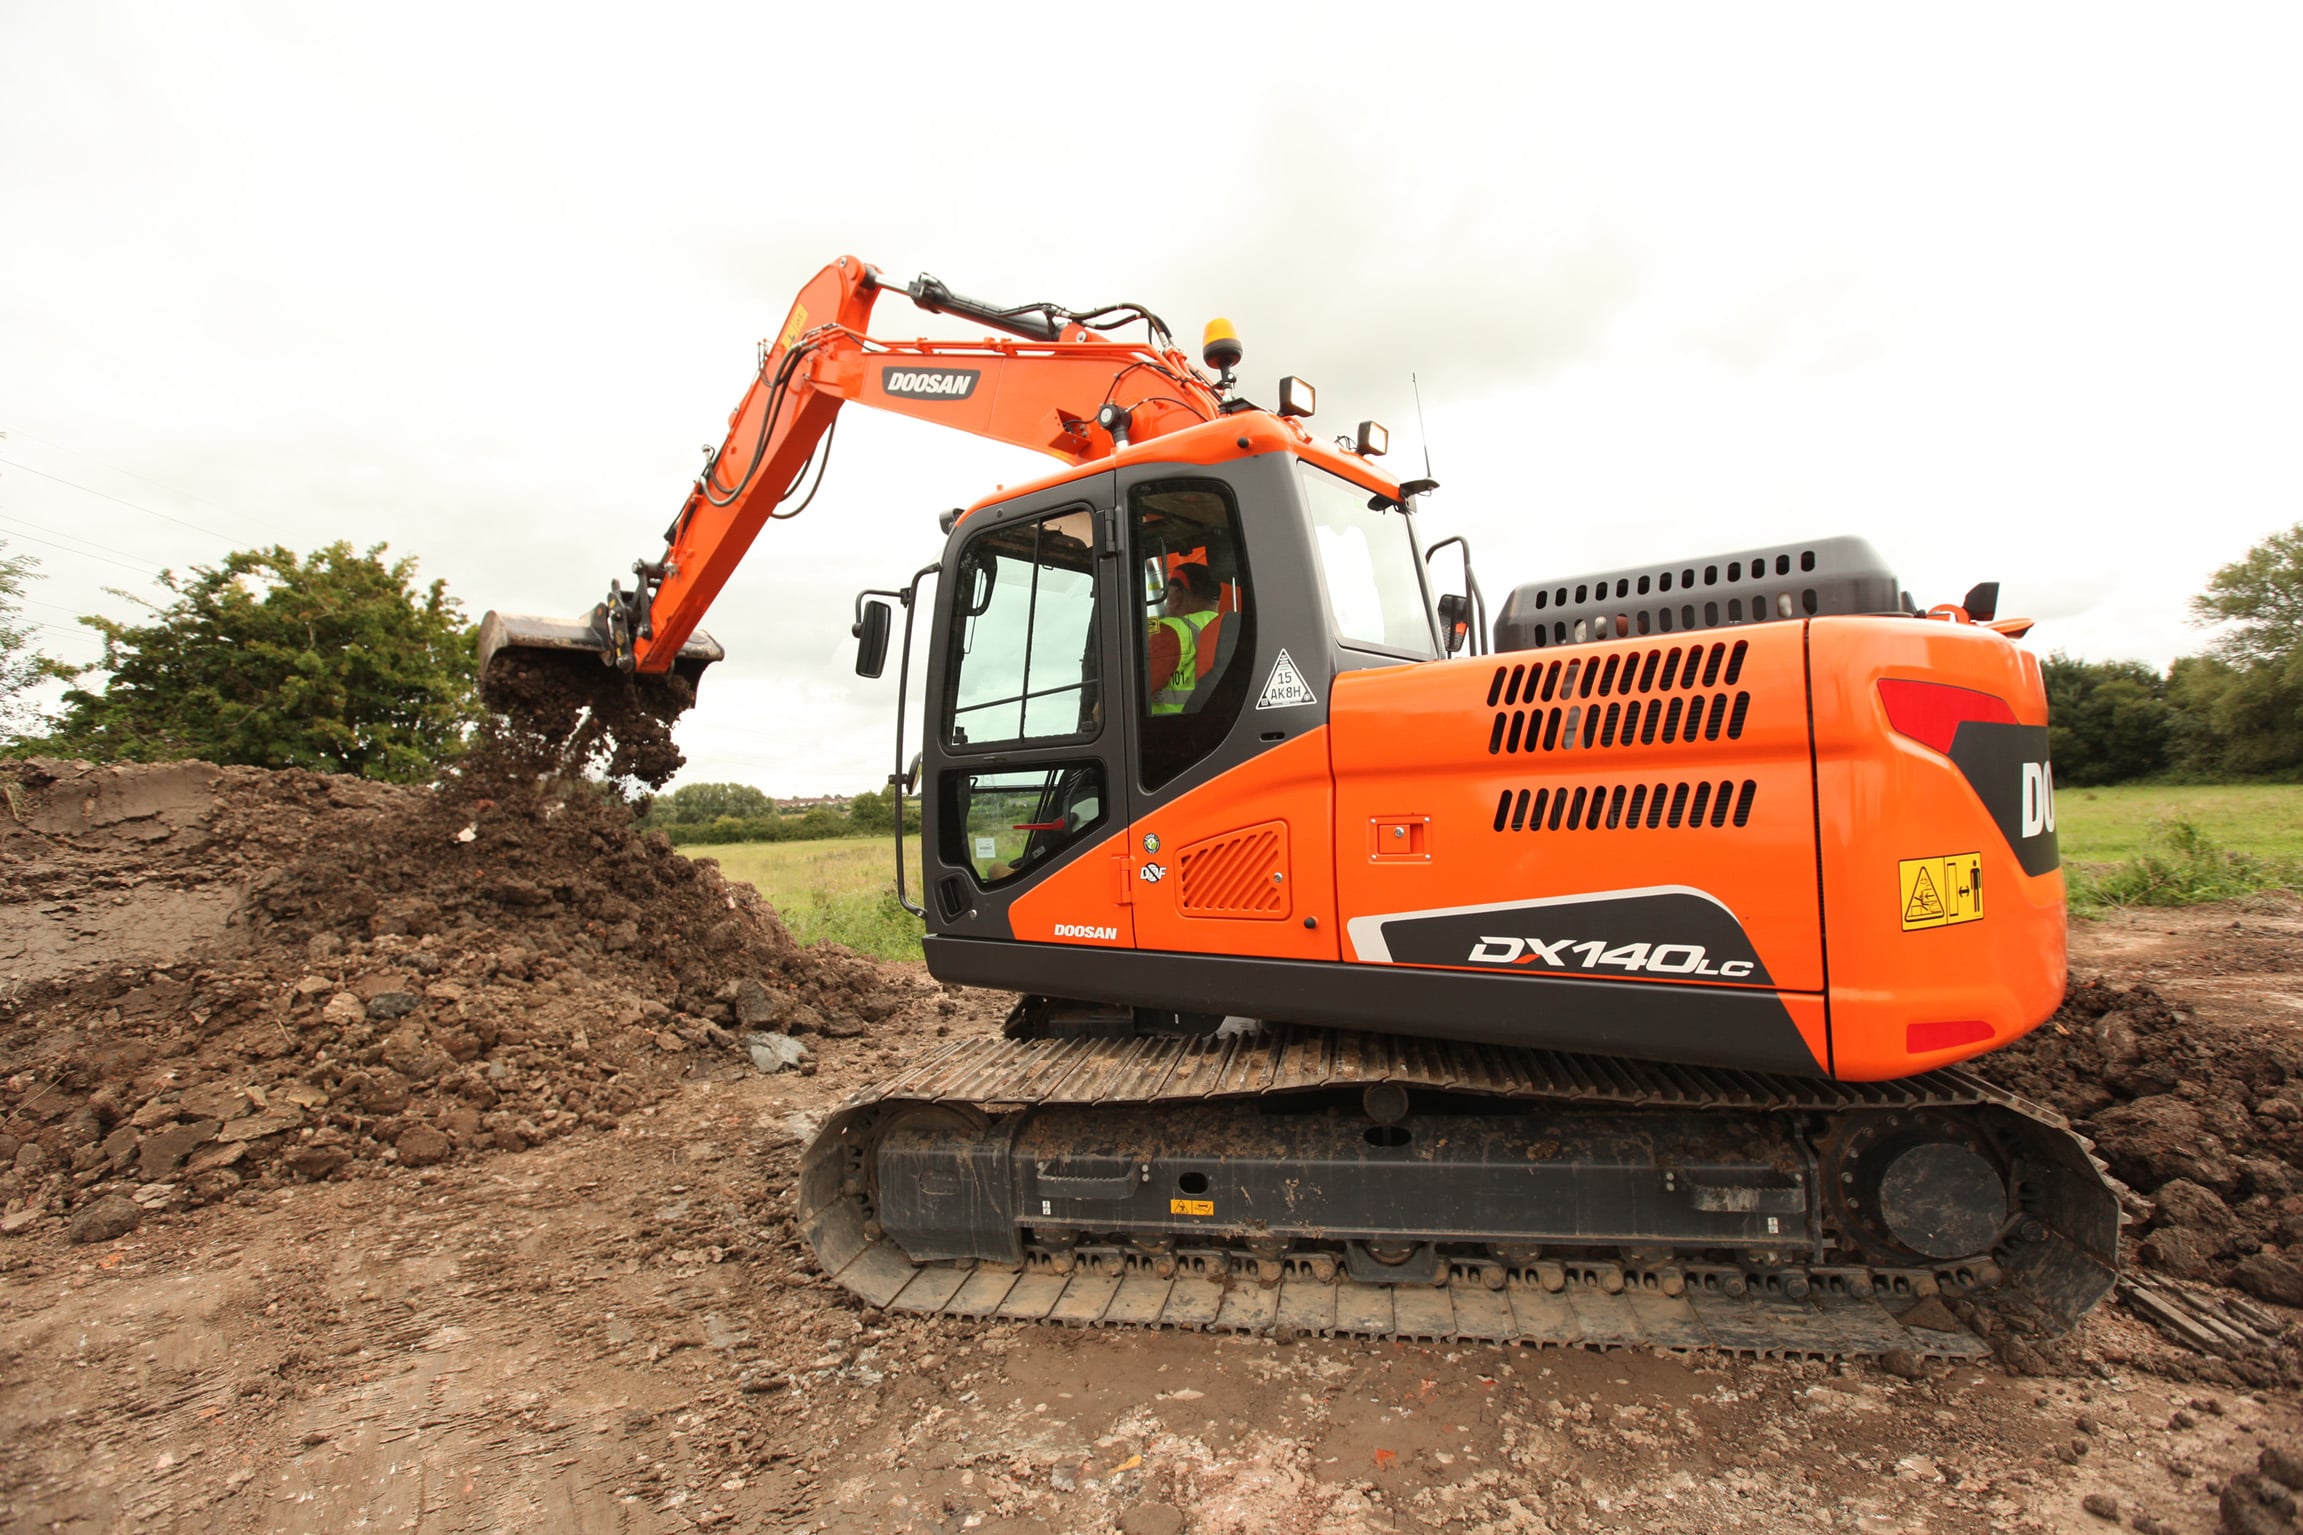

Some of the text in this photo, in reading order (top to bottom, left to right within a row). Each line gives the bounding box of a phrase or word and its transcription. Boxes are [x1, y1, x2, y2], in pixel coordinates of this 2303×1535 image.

[887, 372, 971, 395] DOOSAN
[1277, 672, 1292, 684] 15
[1271, 686, 1301, 700] AK8H
[1054, 924, 1117, 940] DOOSAN
